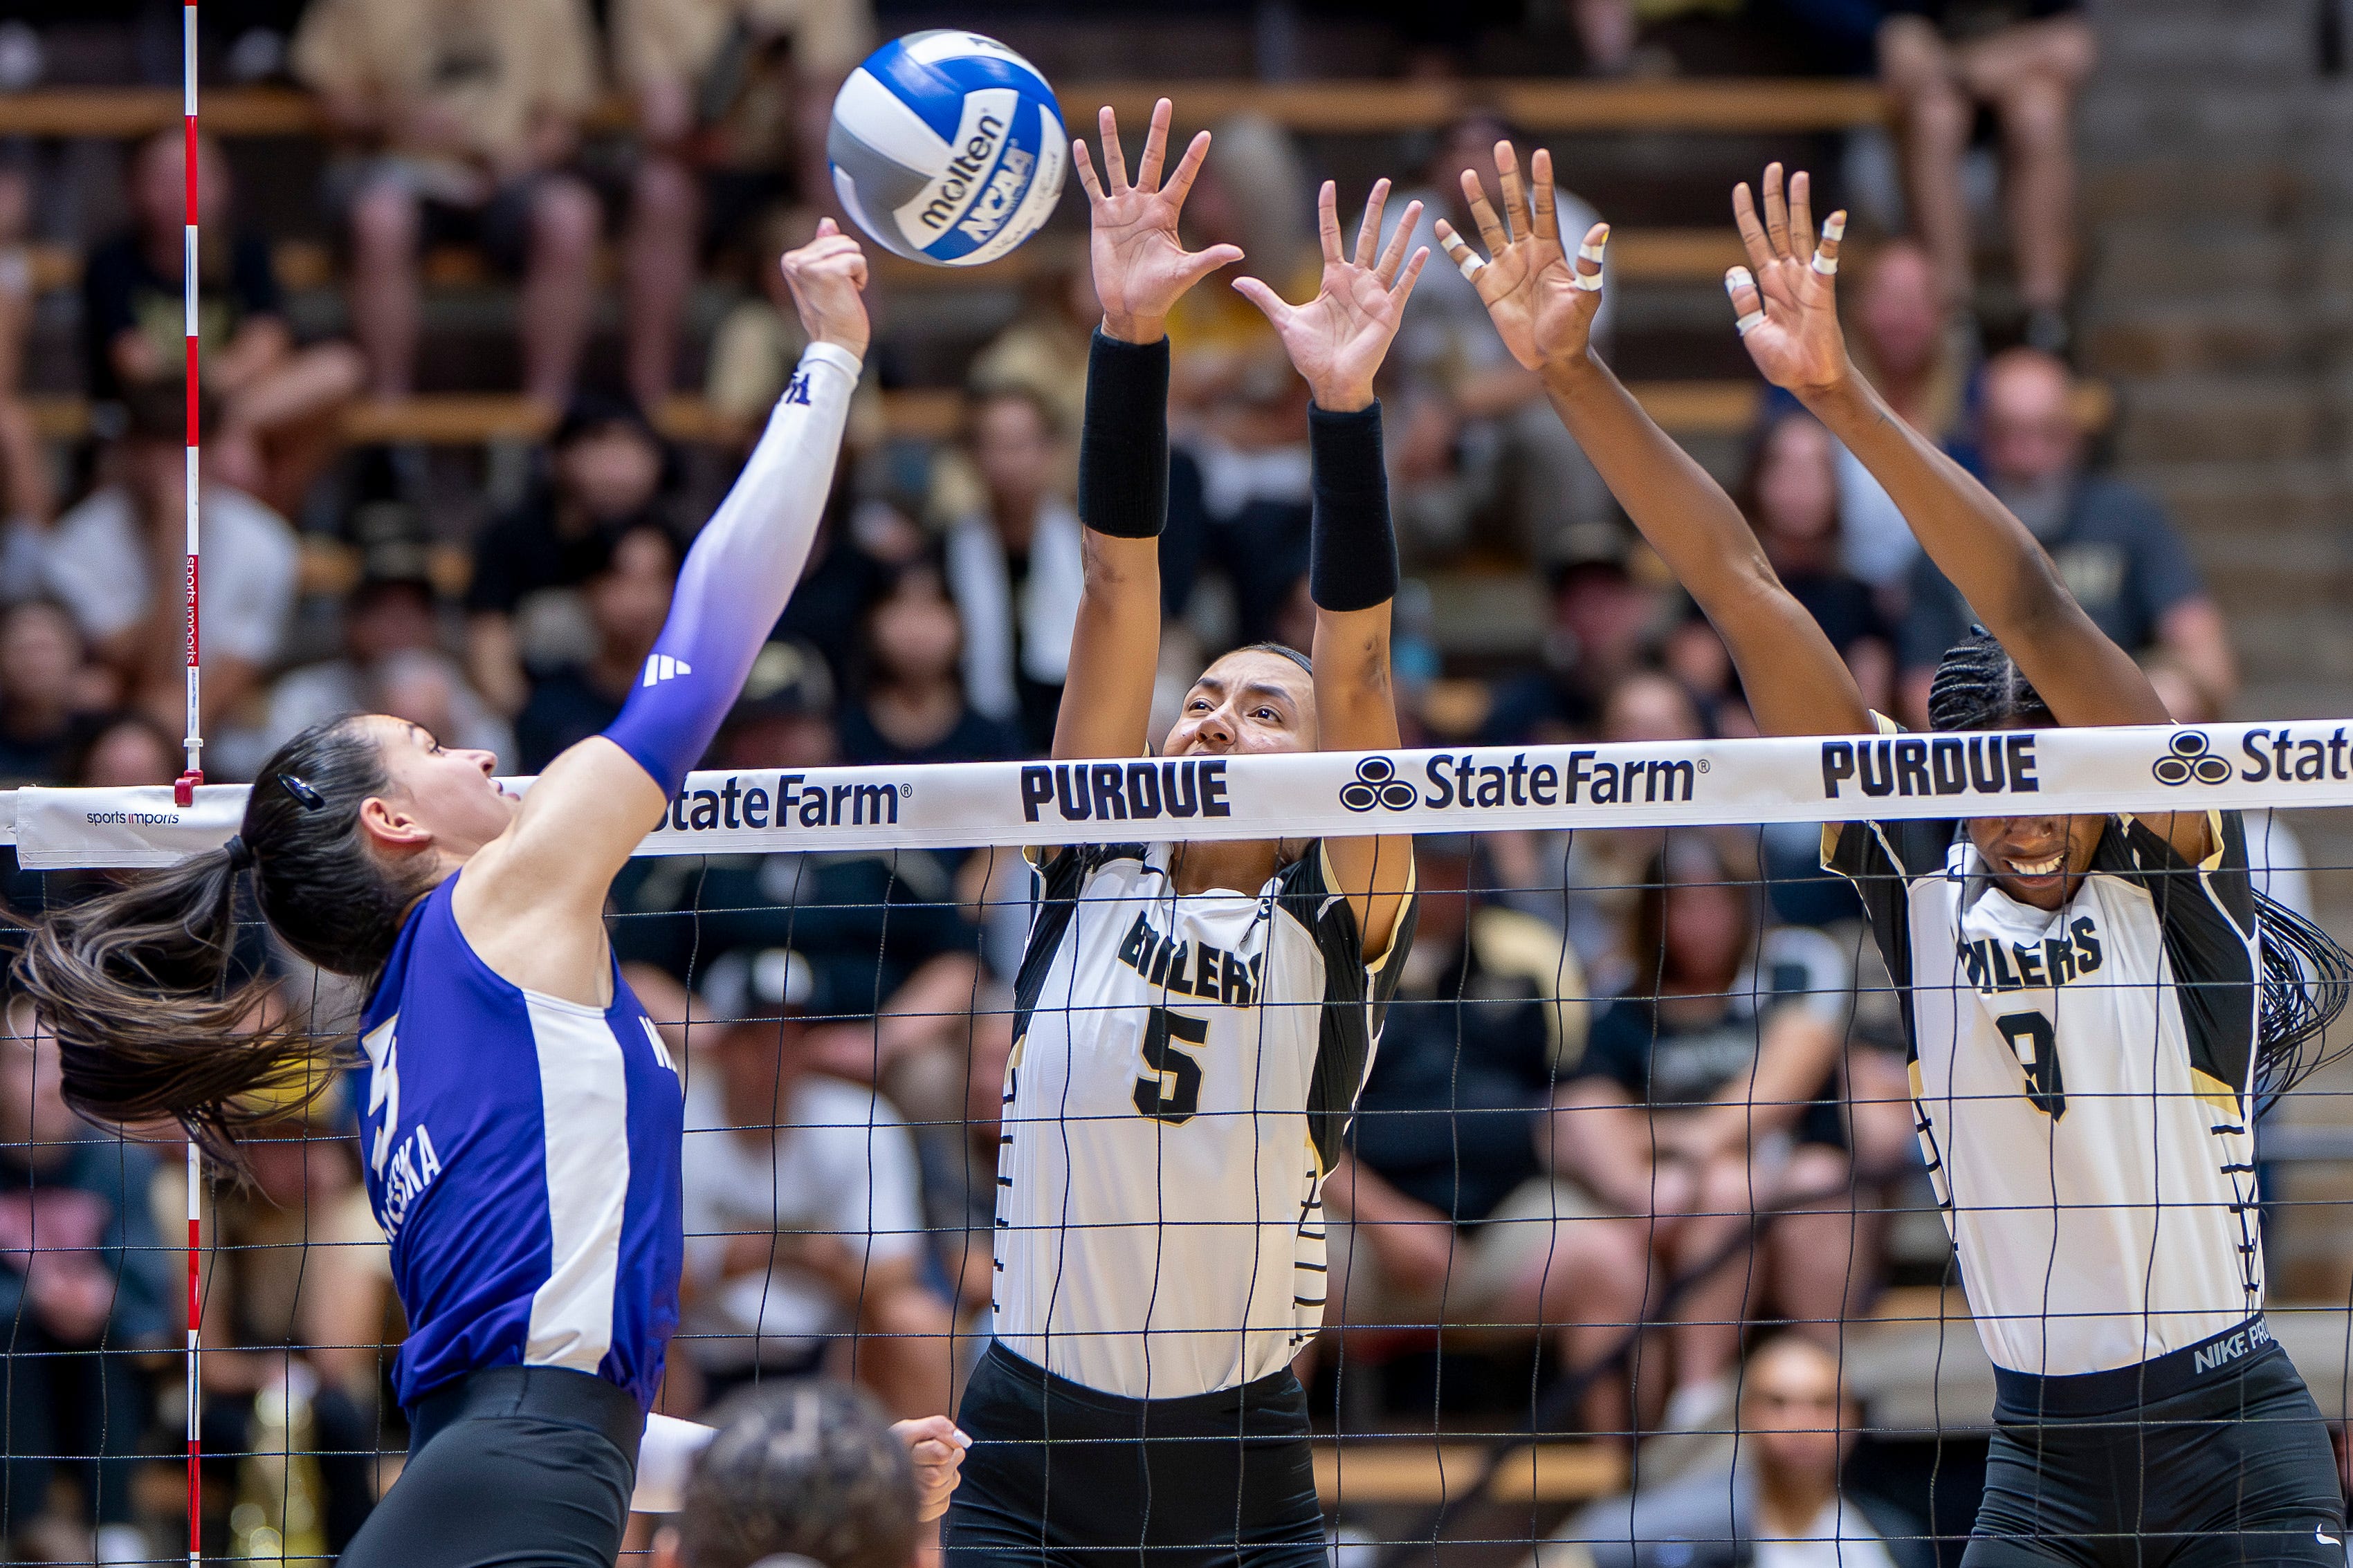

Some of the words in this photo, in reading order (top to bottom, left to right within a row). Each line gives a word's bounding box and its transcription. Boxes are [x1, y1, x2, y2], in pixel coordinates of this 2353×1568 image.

[921, 115, 1003, 230] molten
[958, 147, 1036, 243] NCAA
[1822, 734, 2039, 798] PURDUE
[2242, 727, 2353, 782] Stat
[86, 811, 127, 827] sports
[1021, 760, 1231, 822] PURDUE
[1130, 1006, 1211, 1128] 5
[2195, 1331, 2249, 1374] NIKE
